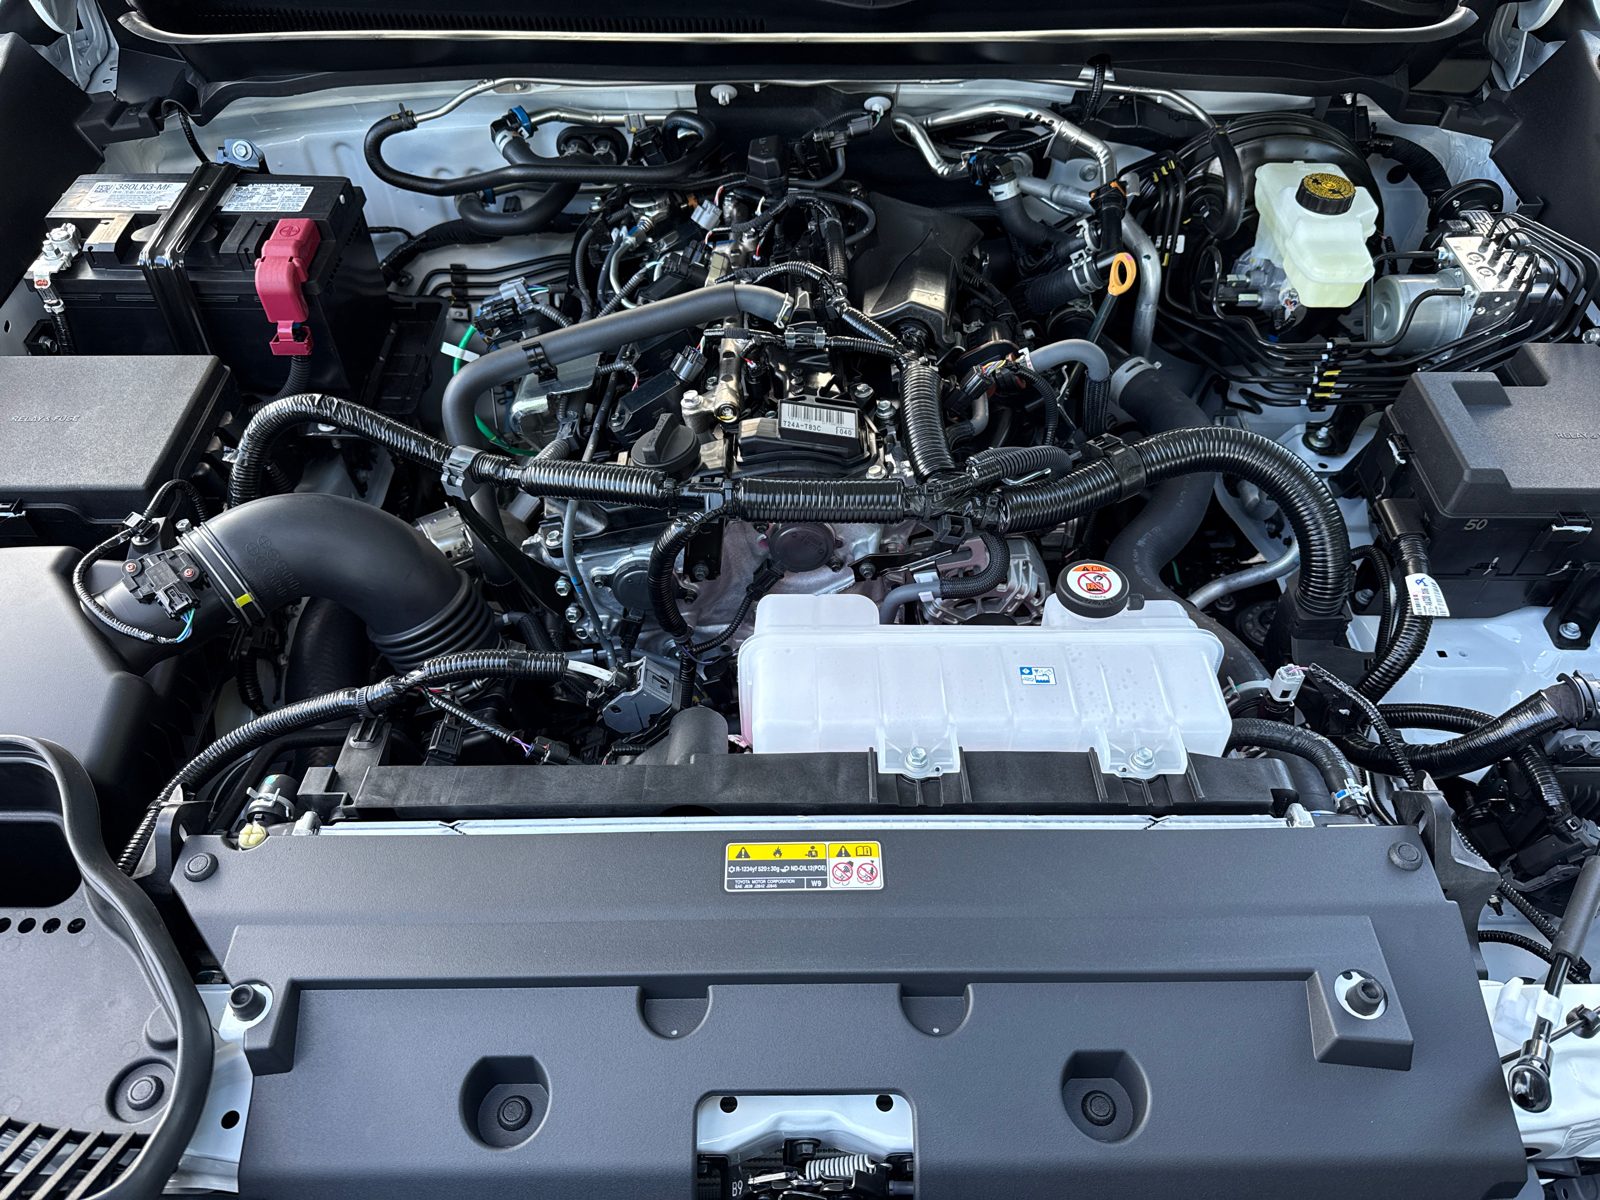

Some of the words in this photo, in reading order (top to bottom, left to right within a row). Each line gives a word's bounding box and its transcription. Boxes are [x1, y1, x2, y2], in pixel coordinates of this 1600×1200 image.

[115, 183, 173, 191] 380LN3-MF
[782, 420, 821, 432] T24A-T83C
[1463, 518, 1489, 531] 50
[731, 1180, 744, 1197] B9
